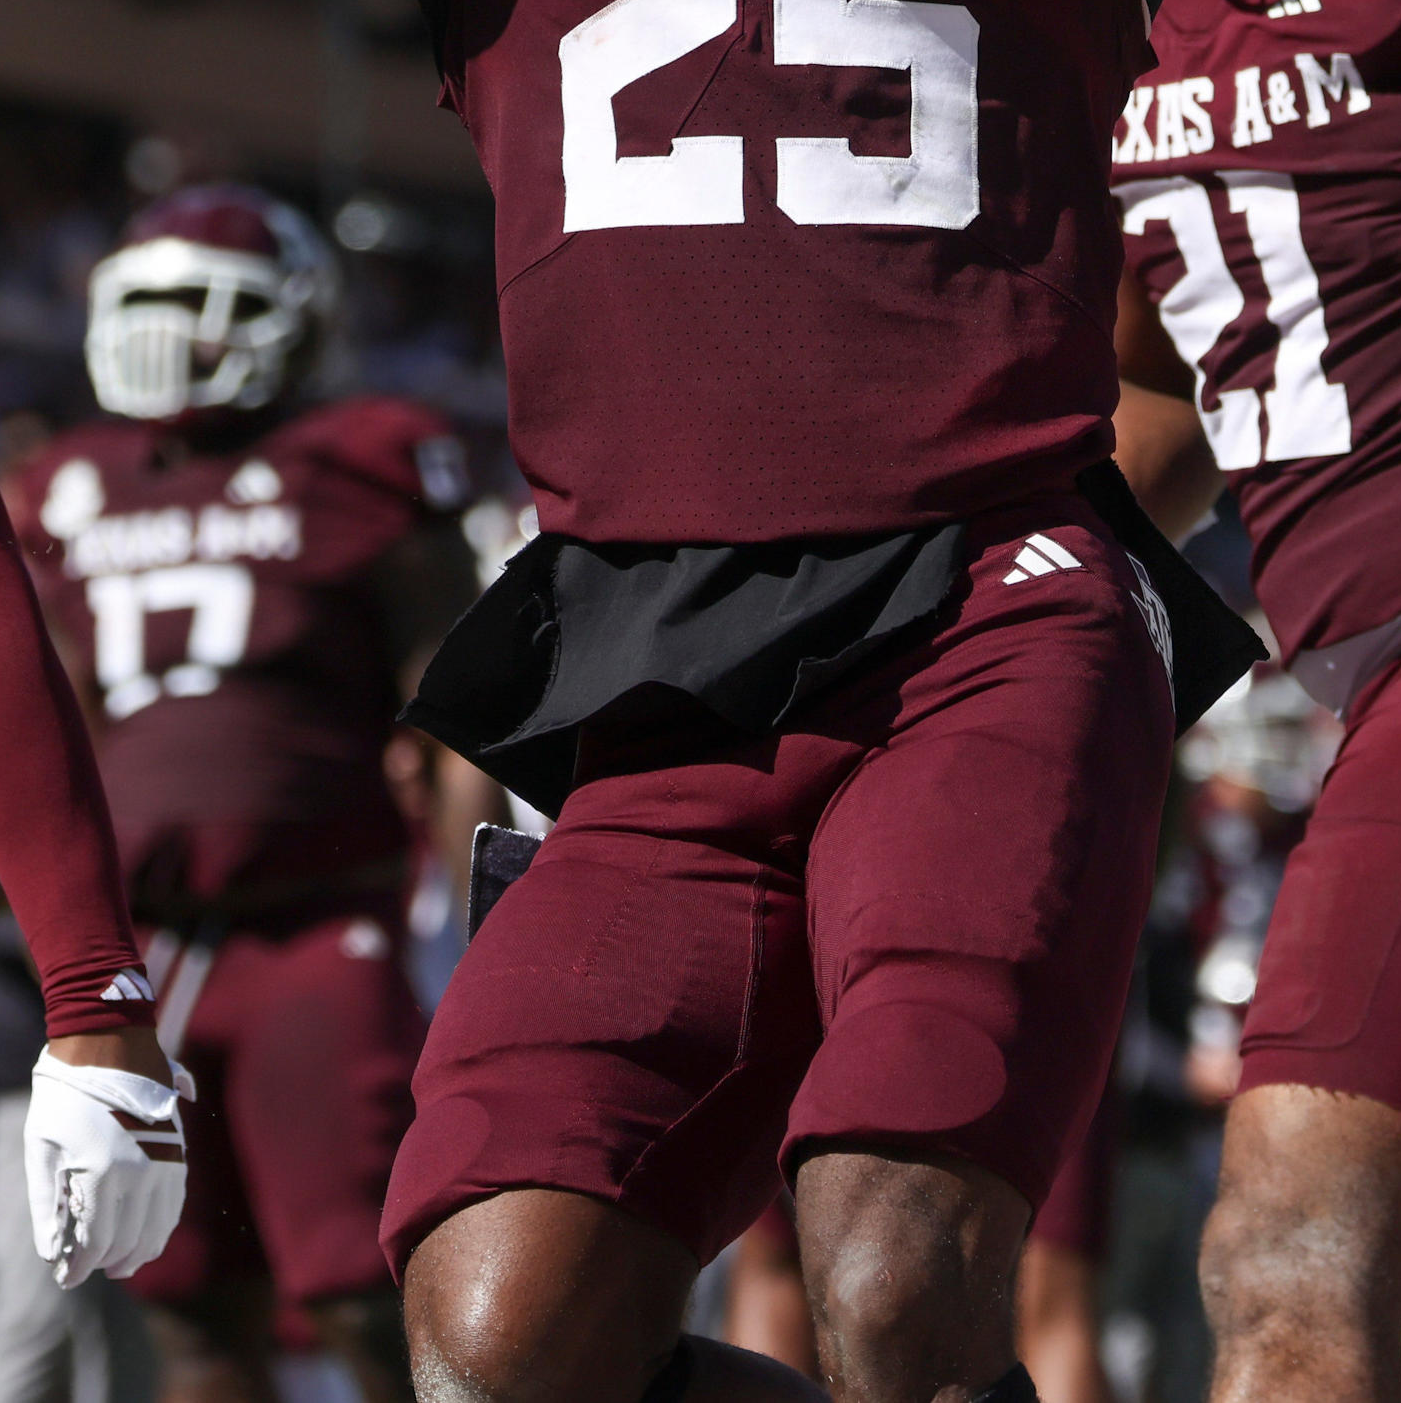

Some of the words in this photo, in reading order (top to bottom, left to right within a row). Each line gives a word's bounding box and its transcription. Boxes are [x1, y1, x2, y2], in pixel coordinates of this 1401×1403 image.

[1112, 77, 1215, 164] XAS
[1231, 52, 1371, 148] A&M
[1110, 168, 1353, 472] 21
[86, 564, 254, 719] 17
